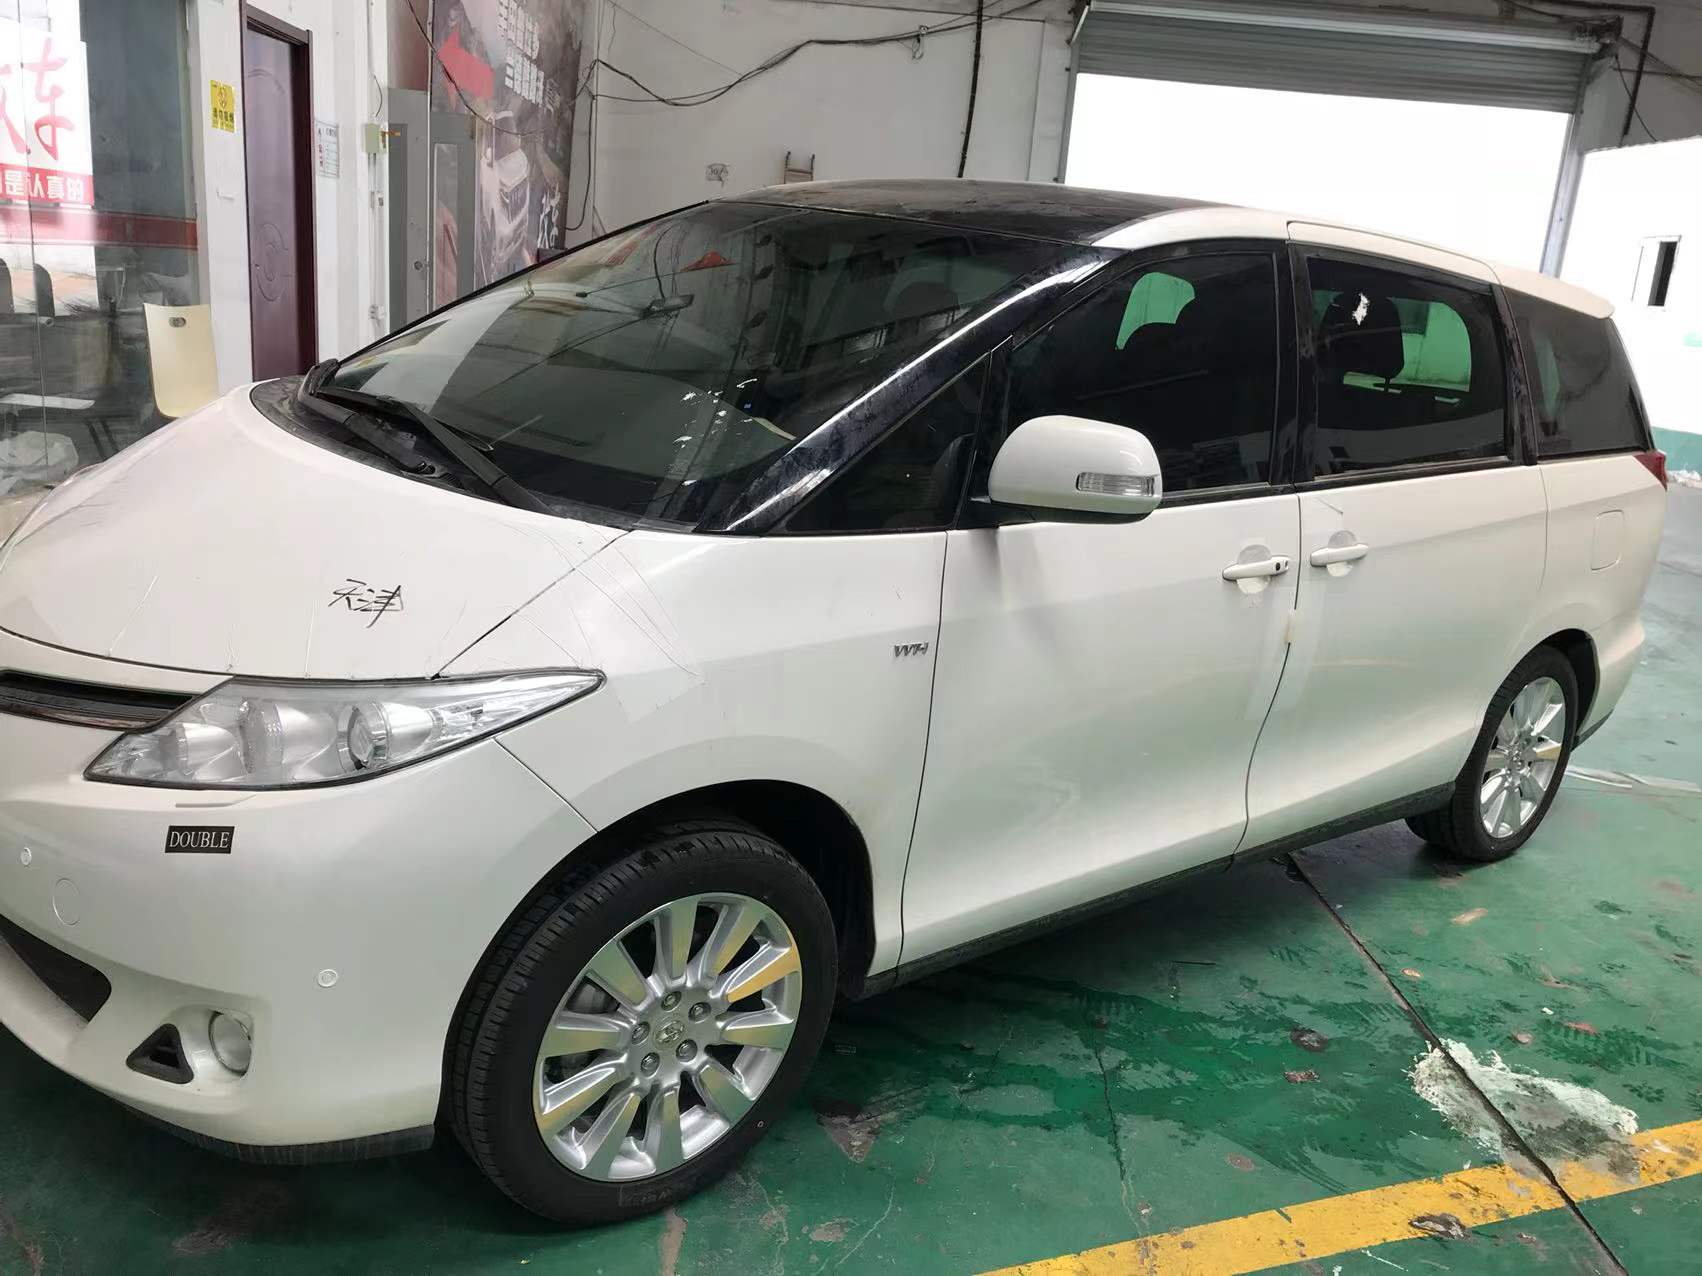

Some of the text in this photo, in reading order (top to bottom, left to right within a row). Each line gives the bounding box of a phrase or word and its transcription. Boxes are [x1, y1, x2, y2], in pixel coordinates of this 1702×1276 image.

[0, 169, 84, 202] 是认真的
[327, 578, 404, 629] 天津
[169, 831, 230, 848] DOUBLE
